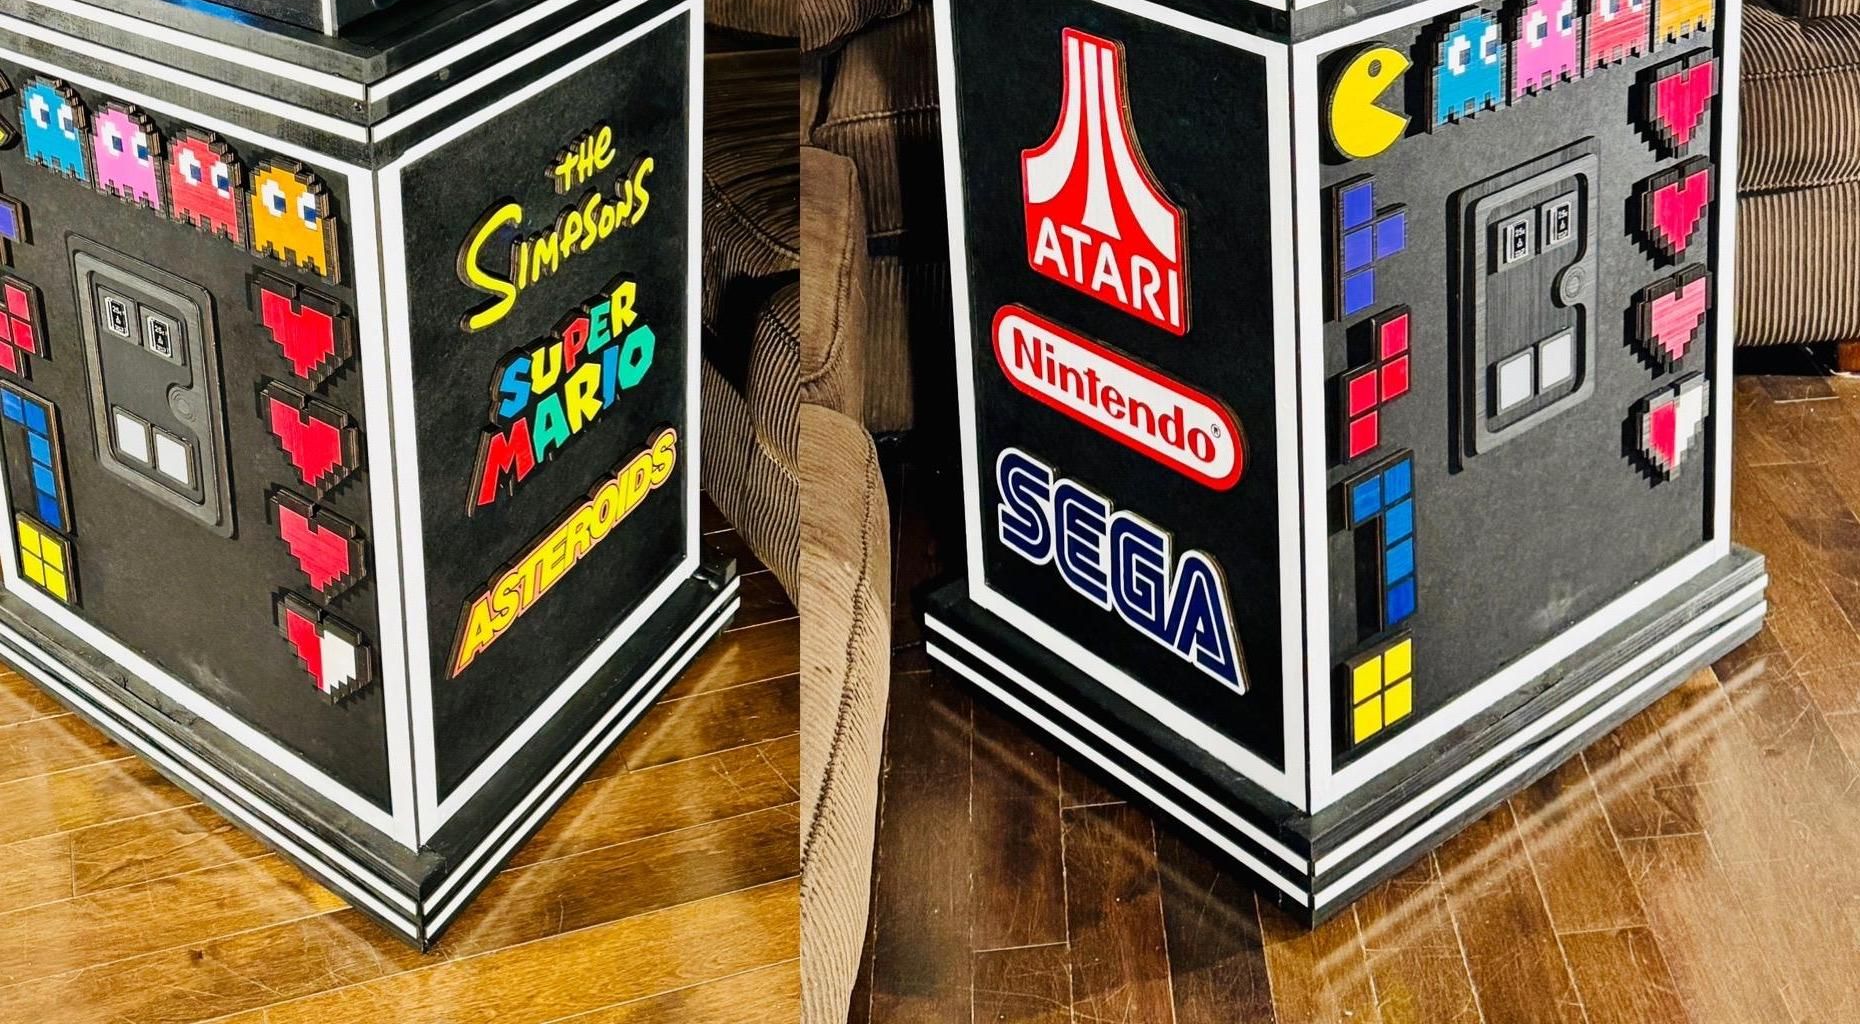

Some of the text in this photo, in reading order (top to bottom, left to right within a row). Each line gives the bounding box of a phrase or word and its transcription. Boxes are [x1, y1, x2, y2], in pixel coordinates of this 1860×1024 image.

[500, 281, 638, 418] SUPER
[1033, 216, 1180, 327] ATARI
[477, 324, 656, 506] MARIO
[1013, 327, 1216, 464] Nintendo
[453, 428, 678, 678] ASTEROIDS
[996, 447, 1246, 696] SEGA
